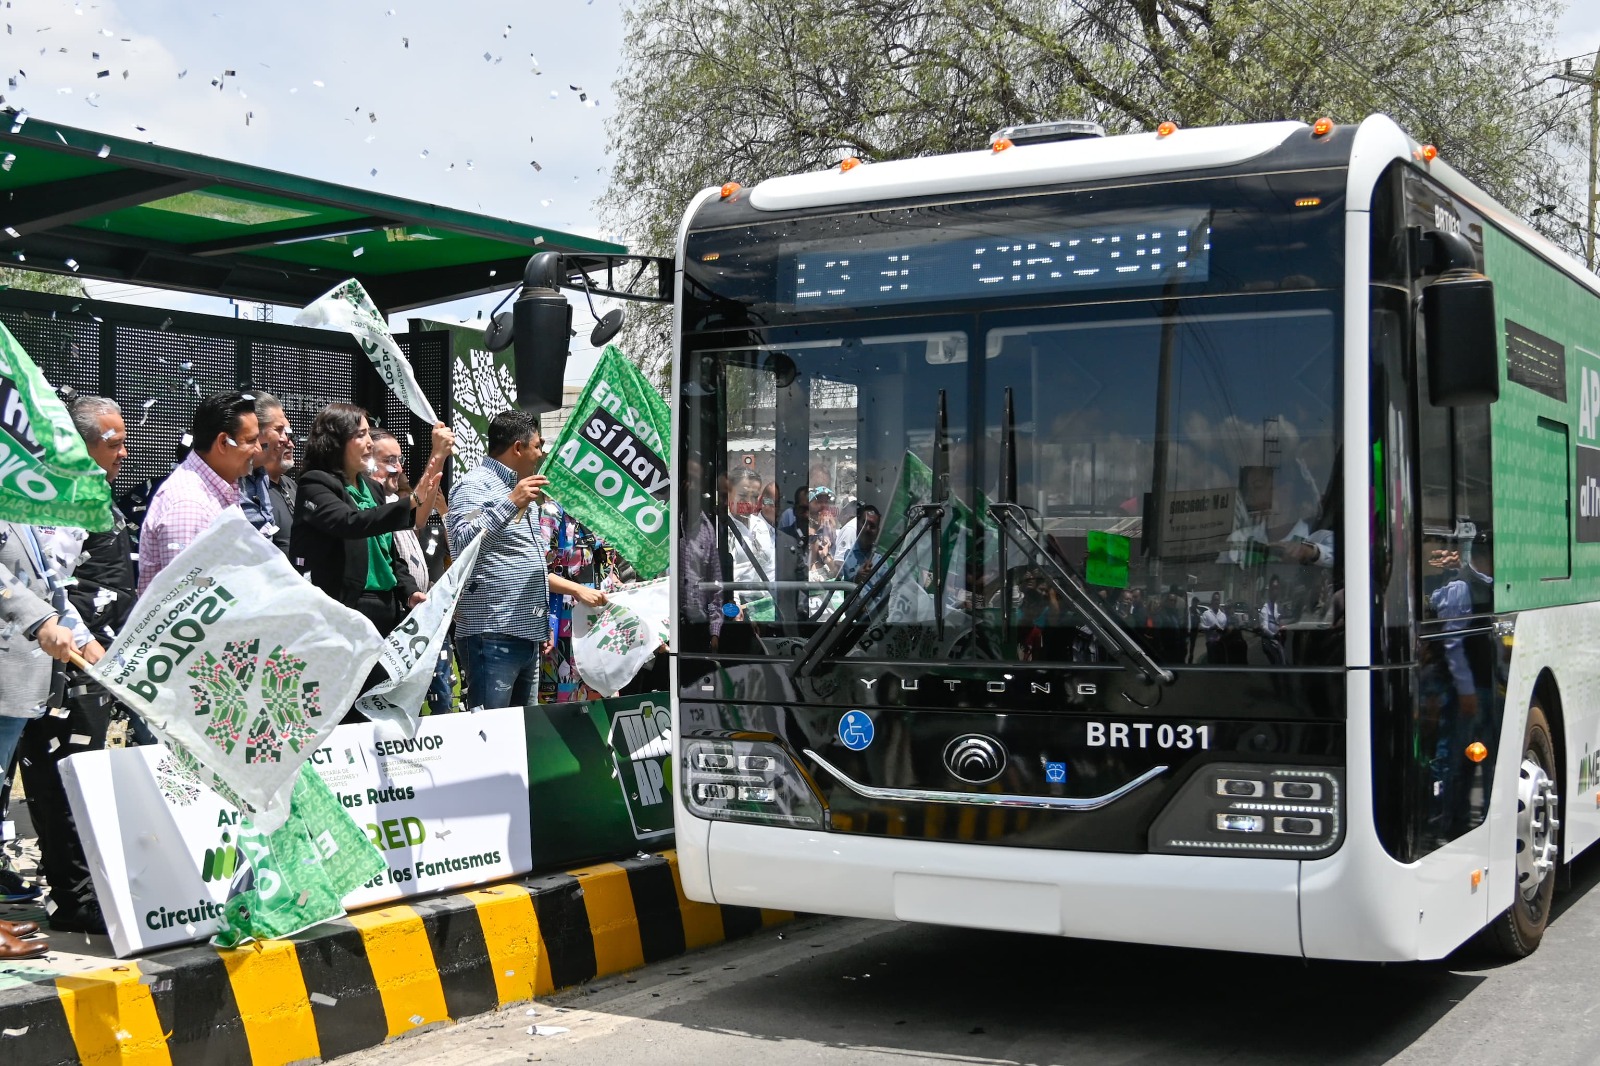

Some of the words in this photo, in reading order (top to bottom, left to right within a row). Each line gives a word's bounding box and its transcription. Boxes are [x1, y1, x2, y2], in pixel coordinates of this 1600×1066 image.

[590, 379, 622, 415] En
[612, 434, 671, 495] hay
[387, 633, 404, 655] ARA
[859, 677, 1097, 696] YUTONG
[375, 735, 444, 757] SEDUVOP
[1086, 721, 1210, 751] BRT031
[366, 785, 415, 805] Rutas
[145, 900, 226, 930] Circuito
[386, 866, 413, 885] los
[415, 849, 501, 879] Fantasmas
